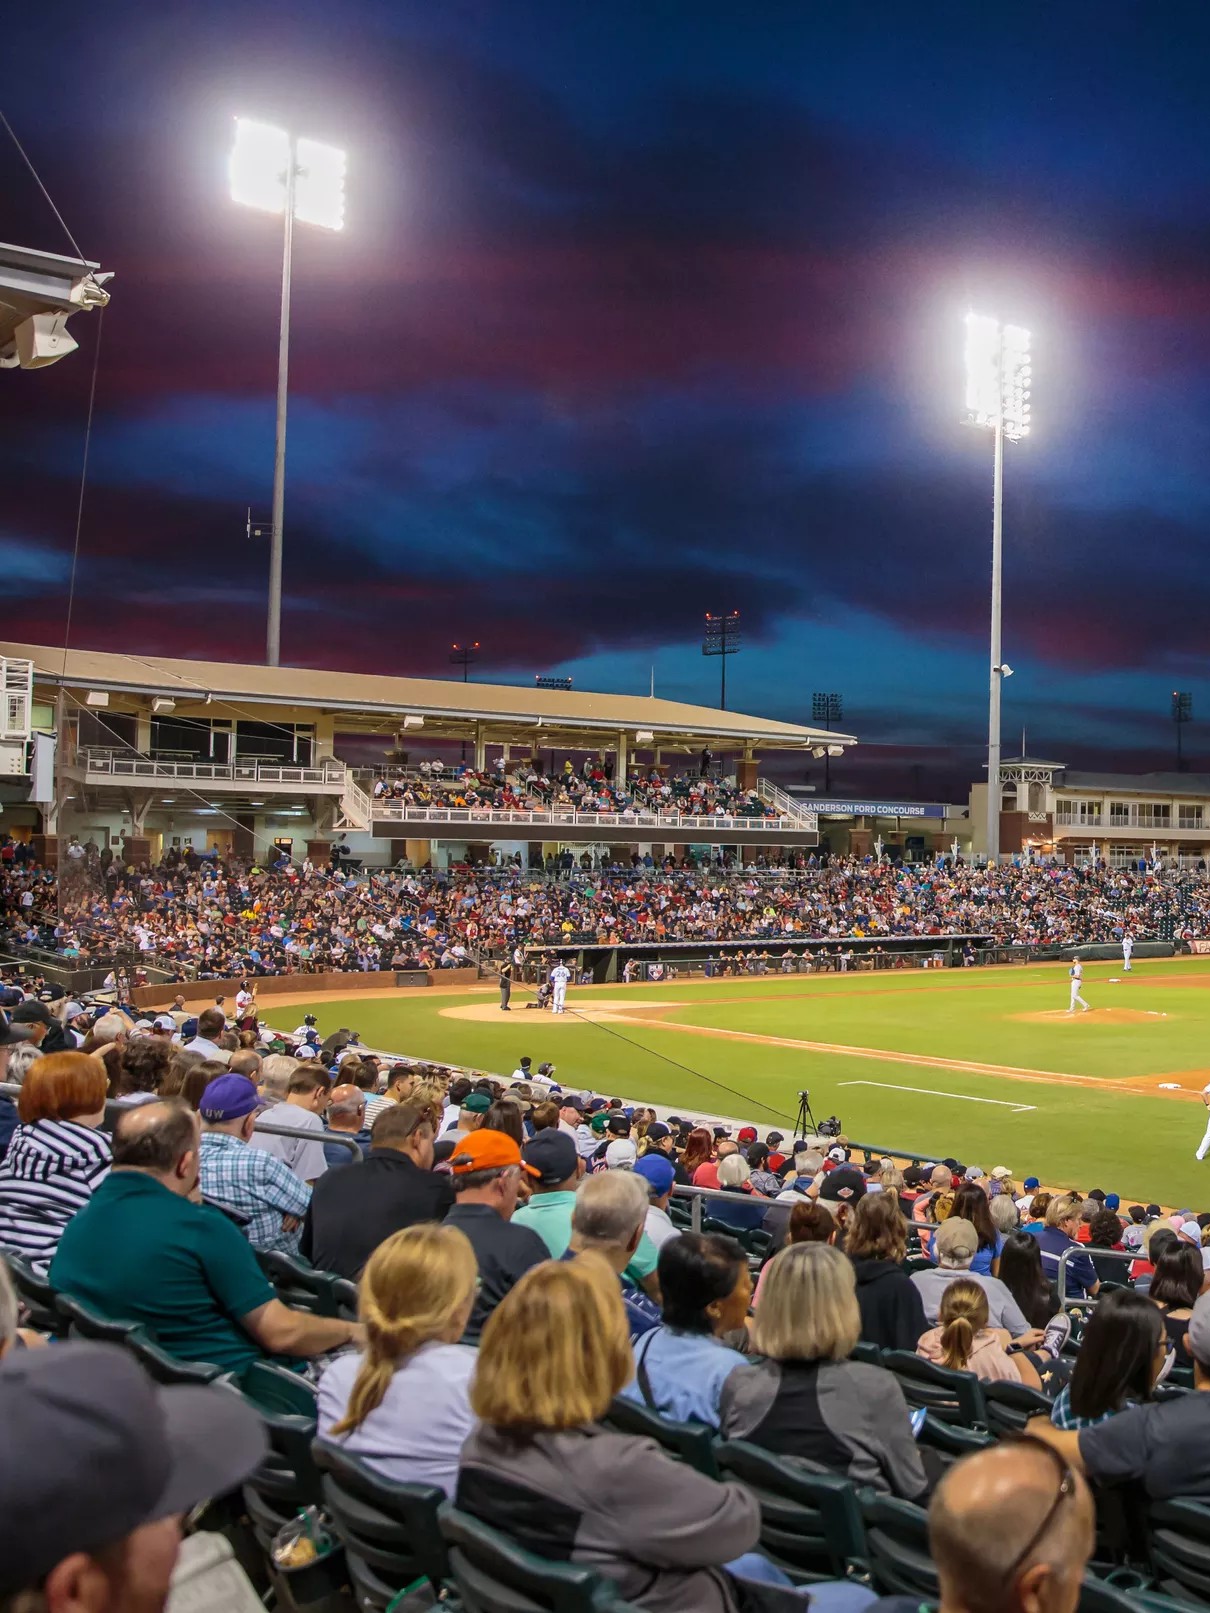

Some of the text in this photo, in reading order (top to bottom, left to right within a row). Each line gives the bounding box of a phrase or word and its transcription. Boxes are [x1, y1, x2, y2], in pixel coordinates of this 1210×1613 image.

[802, 803, 925, 815] SANDERSON FORD CONCOURSE
[205, 1108, 224, 1119] UW
